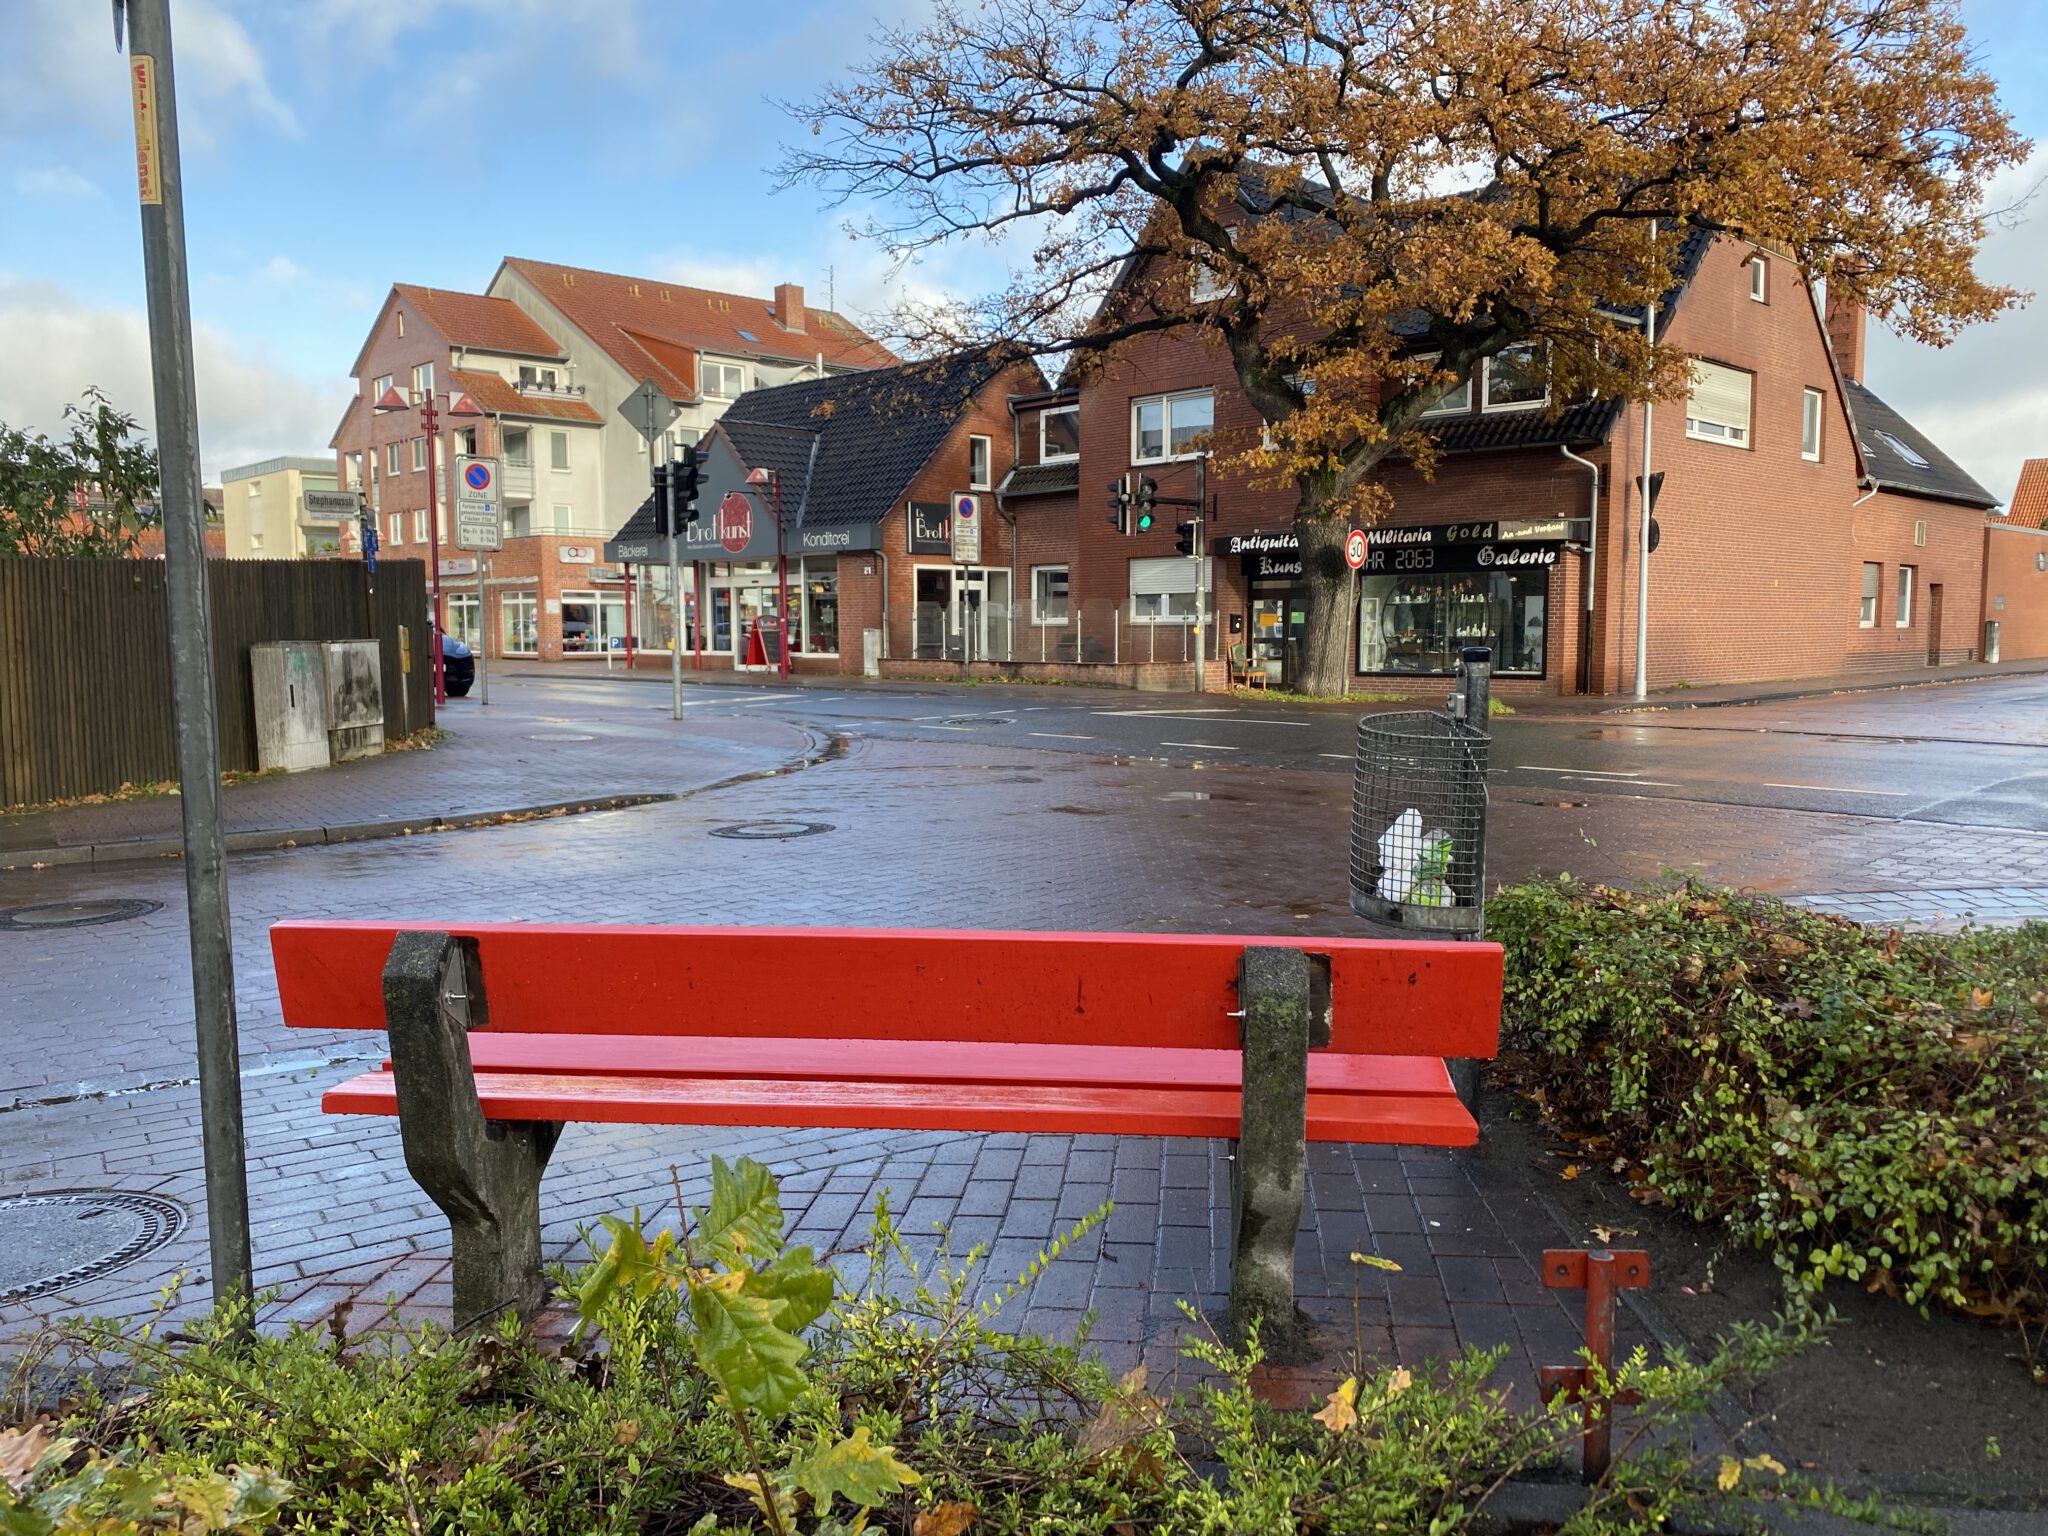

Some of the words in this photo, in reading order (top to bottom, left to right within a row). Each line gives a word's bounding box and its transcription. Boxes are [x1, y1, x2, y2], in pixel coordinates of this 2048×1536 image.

[468, 491, 488, 499] ZONE
[803, 530, 850, 548] Konditorei
[1367, 527, 1432, 544] Militaria
[1446, 523, 1494, 541] Gold
[1502, 531, 1514, 539] An
[1535, 522, 1564, 532] Verkauf
[618, 544, 648, 558] Bäckerei
[1230, 534, 1299, 553] Antiquitä
[1350, 542, 1363, 557] 30
[1395, 548, 1434, 569] 2063
[1477, 545, 1555, 565] Galerie
[1259, 556, 1302, 575] Kuns
[612, 638, 619, 648] P
